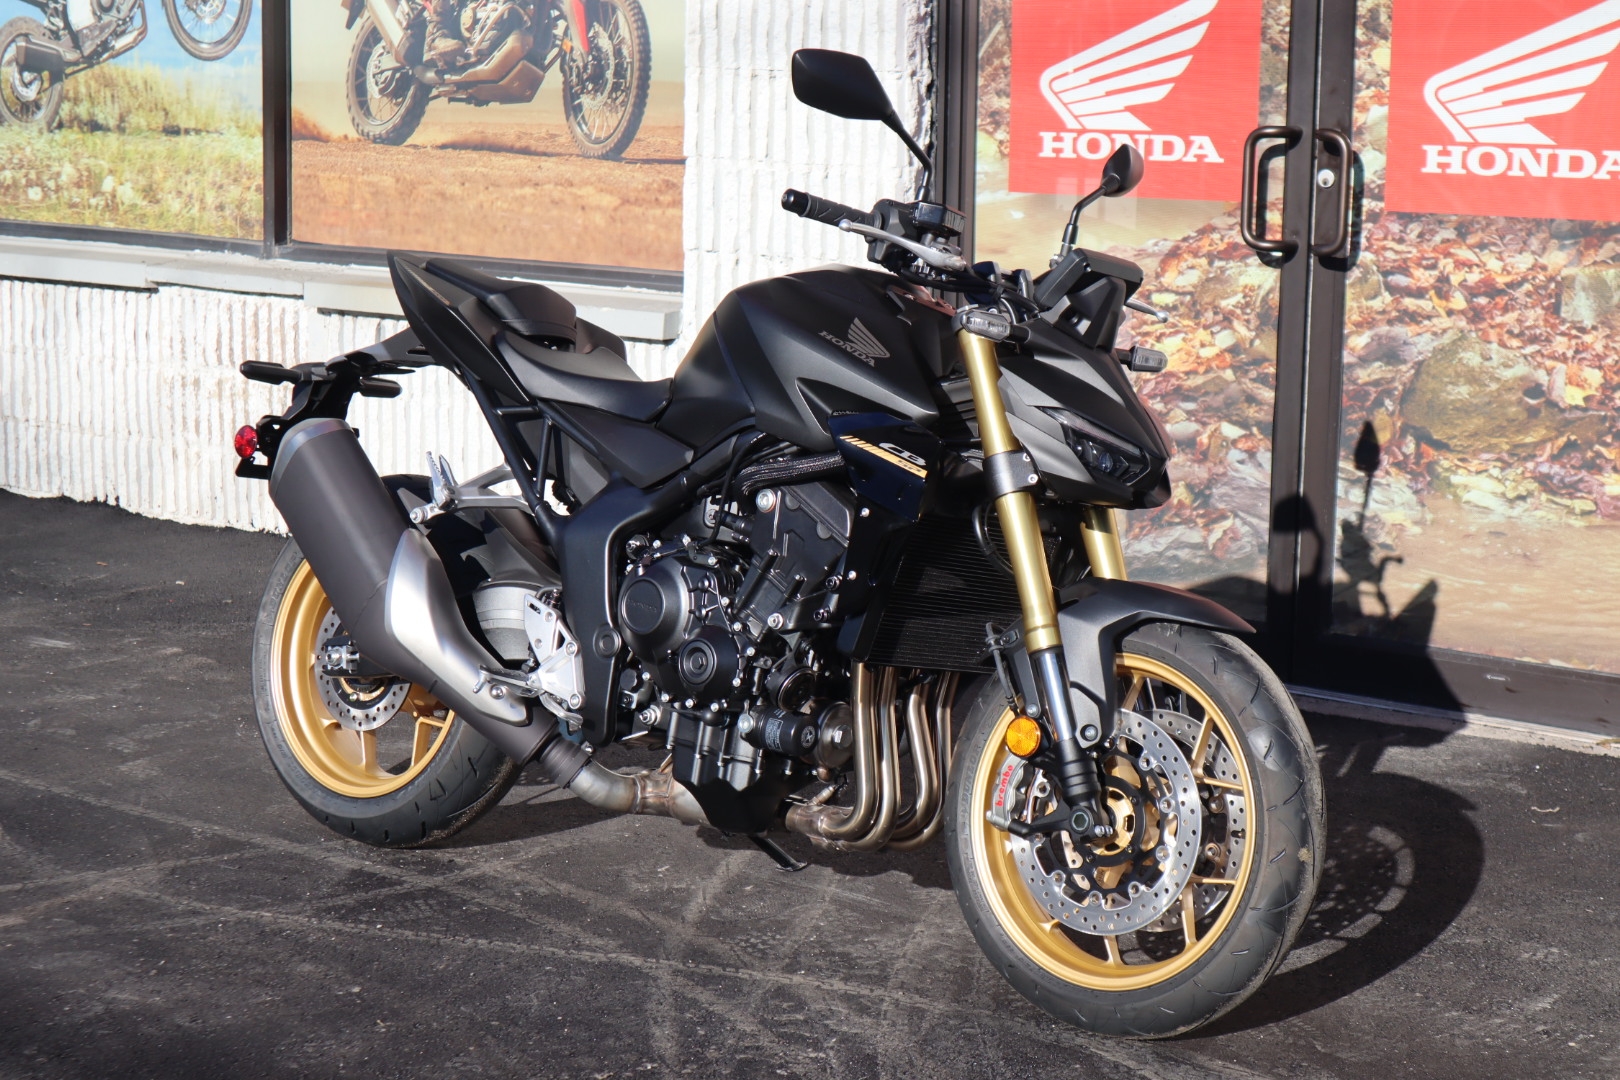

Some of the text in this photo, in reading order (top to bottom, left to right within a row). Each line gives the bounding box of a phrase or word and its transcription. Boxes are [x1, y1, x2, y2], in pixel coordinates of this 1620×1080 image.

[1038, 131, 1225, 163] HONDA
[1420, 144, 1620, 180] HONDA
[818, 330, 875, 367] HONDA
[878, 442, 926, 466] CB
[995, 765, 1014, 806] brembo
